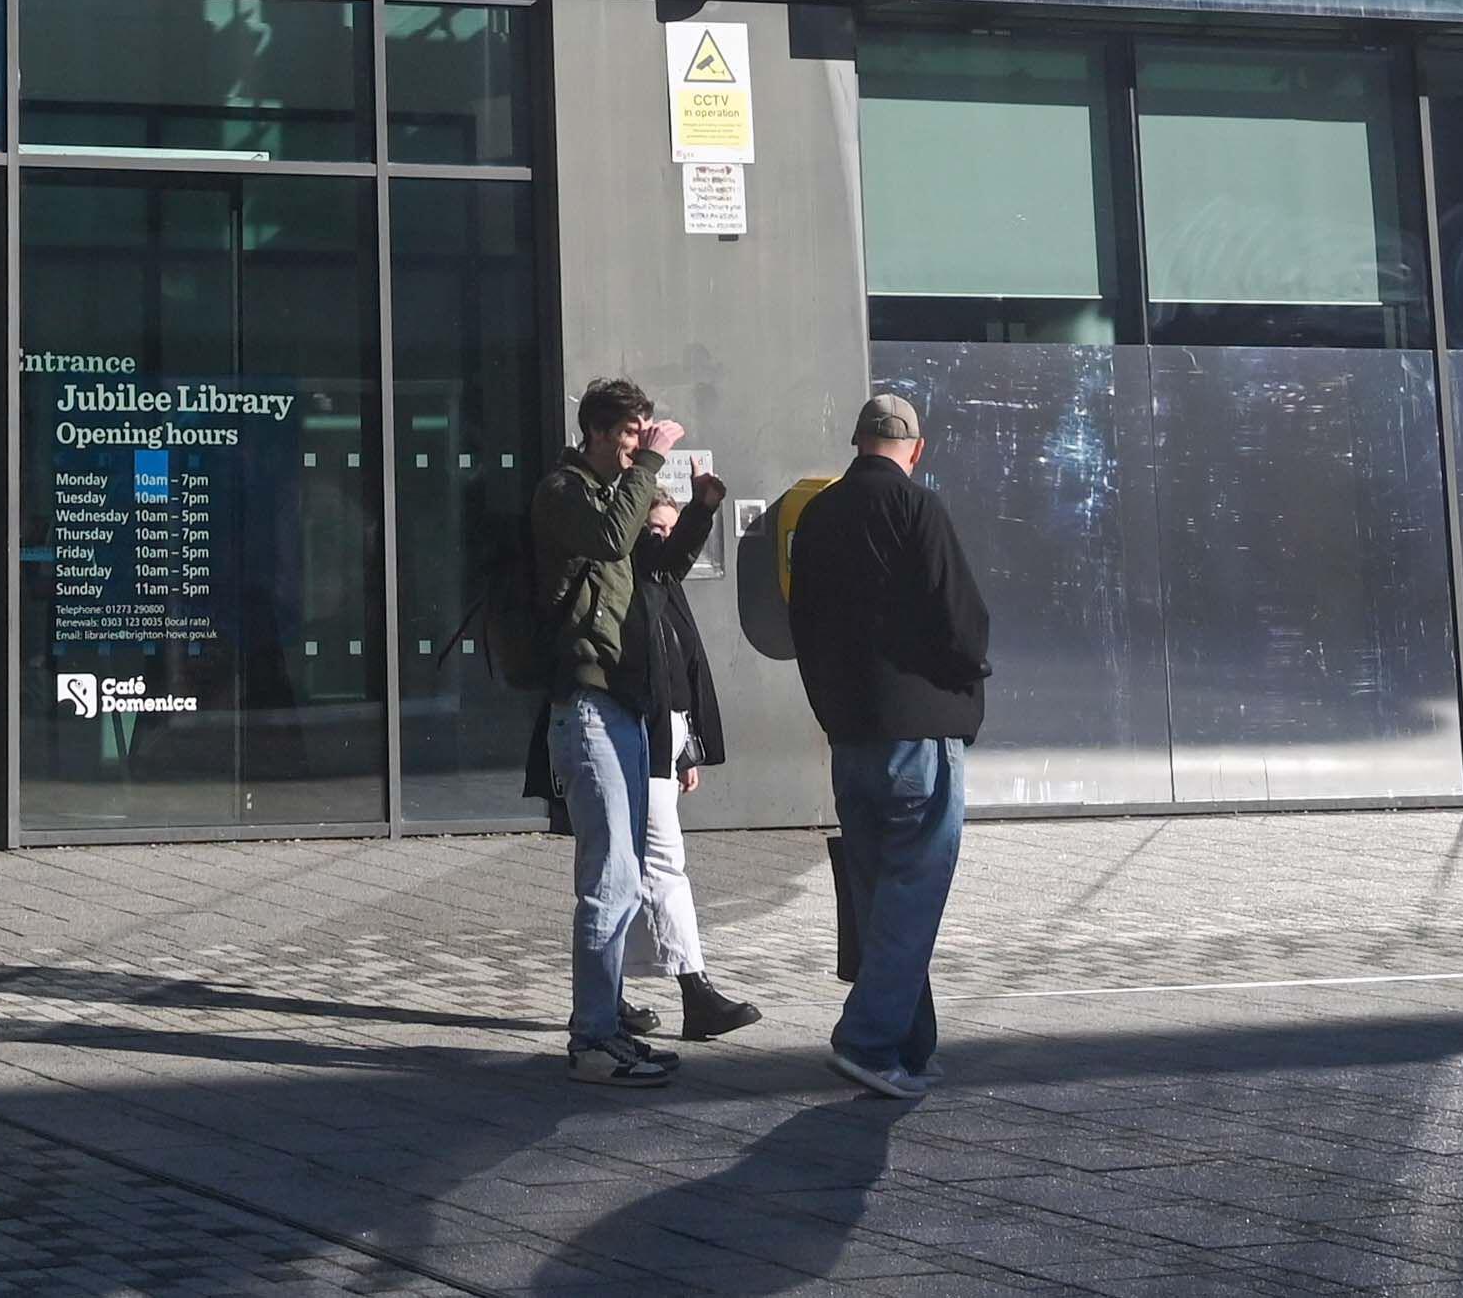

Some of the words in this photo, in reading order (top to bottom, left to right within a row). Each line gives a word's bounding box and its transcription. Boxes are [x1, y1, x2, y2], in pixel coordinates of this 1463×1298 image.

[693, 93, 730, 107] CCTV
[695, 109, 740, 118] operation
[57, 384, 172, 414] Jubilee
[177, 385, 295, 421] Library
[56, 422, 163, 449] Opening
[165, 423, 239, 447] hours
[56, 473, 108, 489] Monday
[134, 473, 168, 486] 10am
[181, 473, 210, 489] 7pm
[56, 491, 106, 507] Tuesday
[134, 491, 168, 504] 10am
[181, 491, 210, 507] 7pm
[56, 509, 129, 525] Wednesday
[134, 509, 168, 523] 10am
[181, 509, 210, 525] 5pm
[56, 528, 114, 544] Thursday
[134, 528, 168, 541] 10am
[181, 528, 210, 544] 7pm
[56, 546, 94, 562] Friday
[134, 546, 168, 559] 10am
[181, 546, 210, 562] 5pm
[56, 564, 112, 580] Saturday
[134, 564, 168, 577] 10am
[181, 564, 210, 580] 5pm
[56, 583, 103, 599] Sunday
[134, 583, 168, 595] 11am
[181, 583, 210, 599] 5pm
[56, 605, 104, 616] Telephone:
[105, 605, 131, 614] 01273
[56, 617, 99, 627] Renewals:
[101, 617, 122, 627] 0303
[125, 617, 140, 627] 123
[142, 617, 163, 627] 0035
[164, 617, 188, 627] (local
[189, 617, 210, 628] rate)
[56, 630, 82, 640] Email:
[101, 675, 146, 695] Café
[102, 694, 197, 713] Domenica
